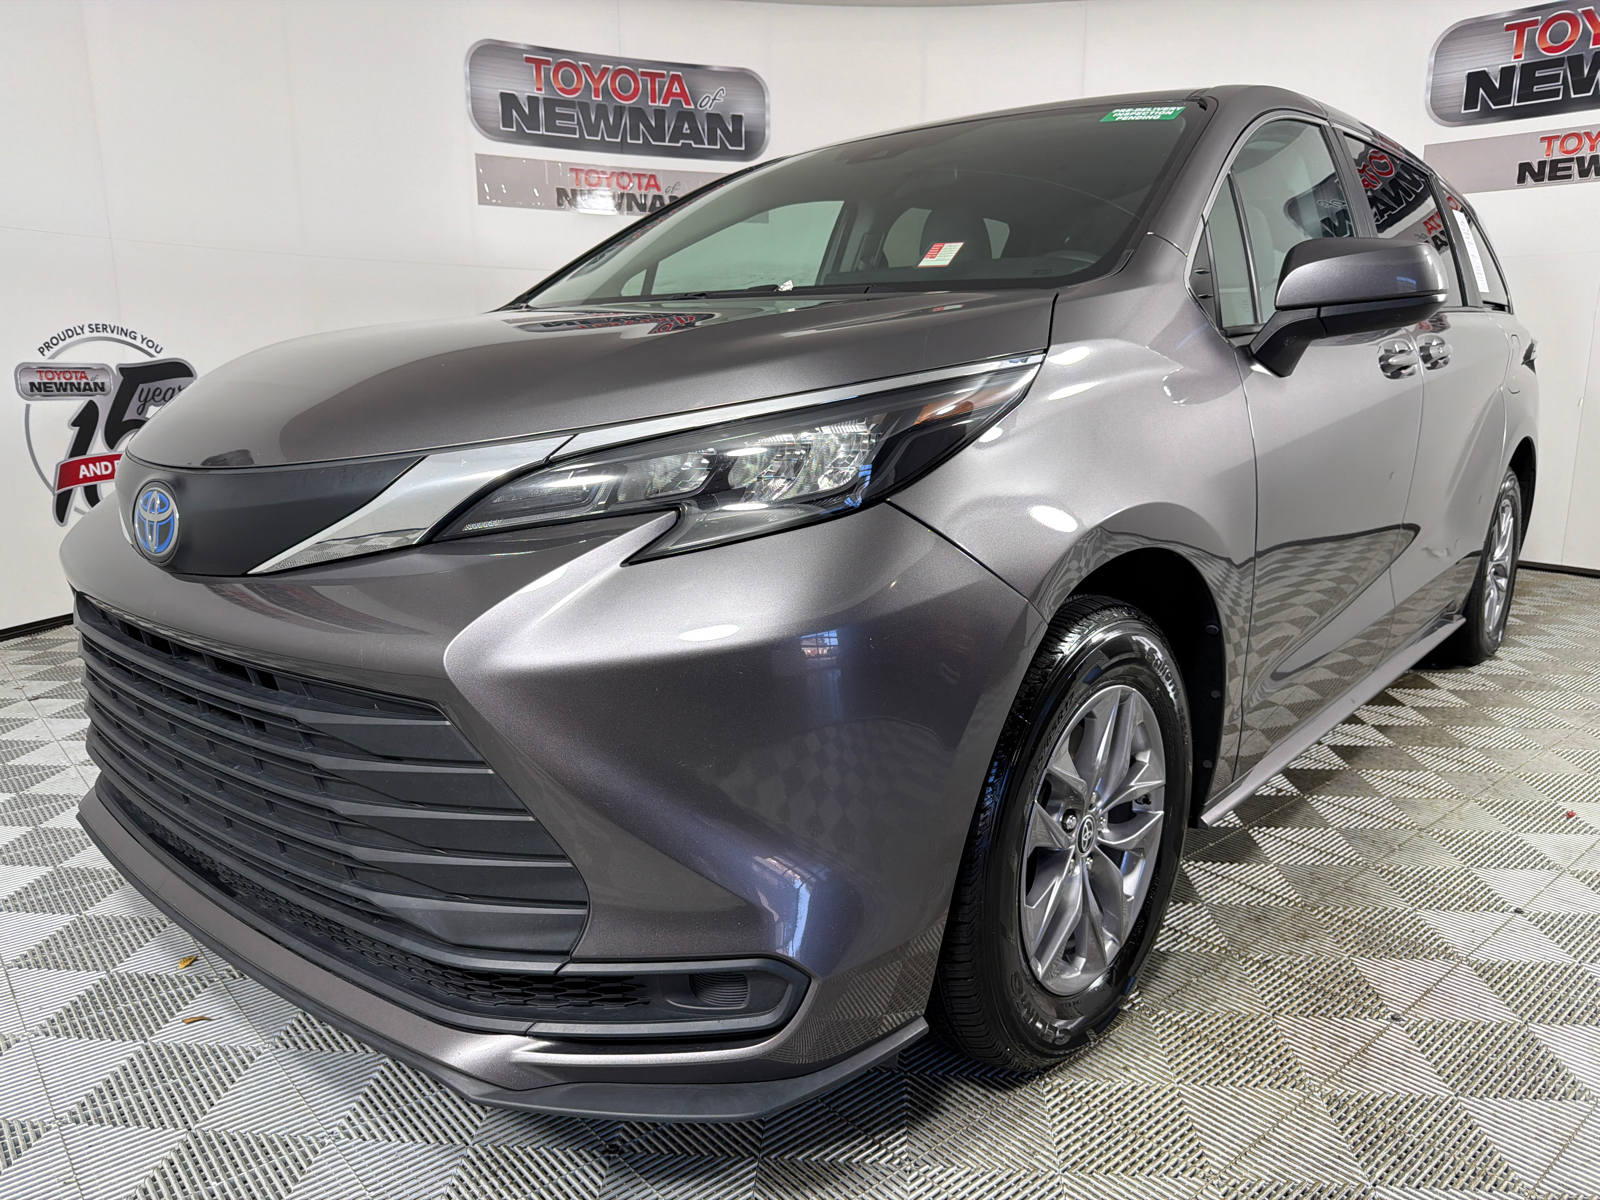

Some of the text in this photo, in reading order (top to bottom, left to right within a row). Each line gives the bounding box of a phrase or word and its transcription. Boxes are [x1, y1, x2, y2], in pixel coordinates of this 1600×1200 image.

[523, 54, 725, 110] TOYOTA of
[499, 91, 746, 150] NEWNAN
[1112, 110, 1175, 118] INSPECTION
[569, 167, 680, 195] TOYOTA of
[556, 186, 682, 214] NNA
[37, 323, 164, 357] PROUDLY SERVING YOU
[29, 381, 106, 393] NEWNAN
[35, 369, 99, 382] TOYOTA of
[78, 460, 112, 479] AND
